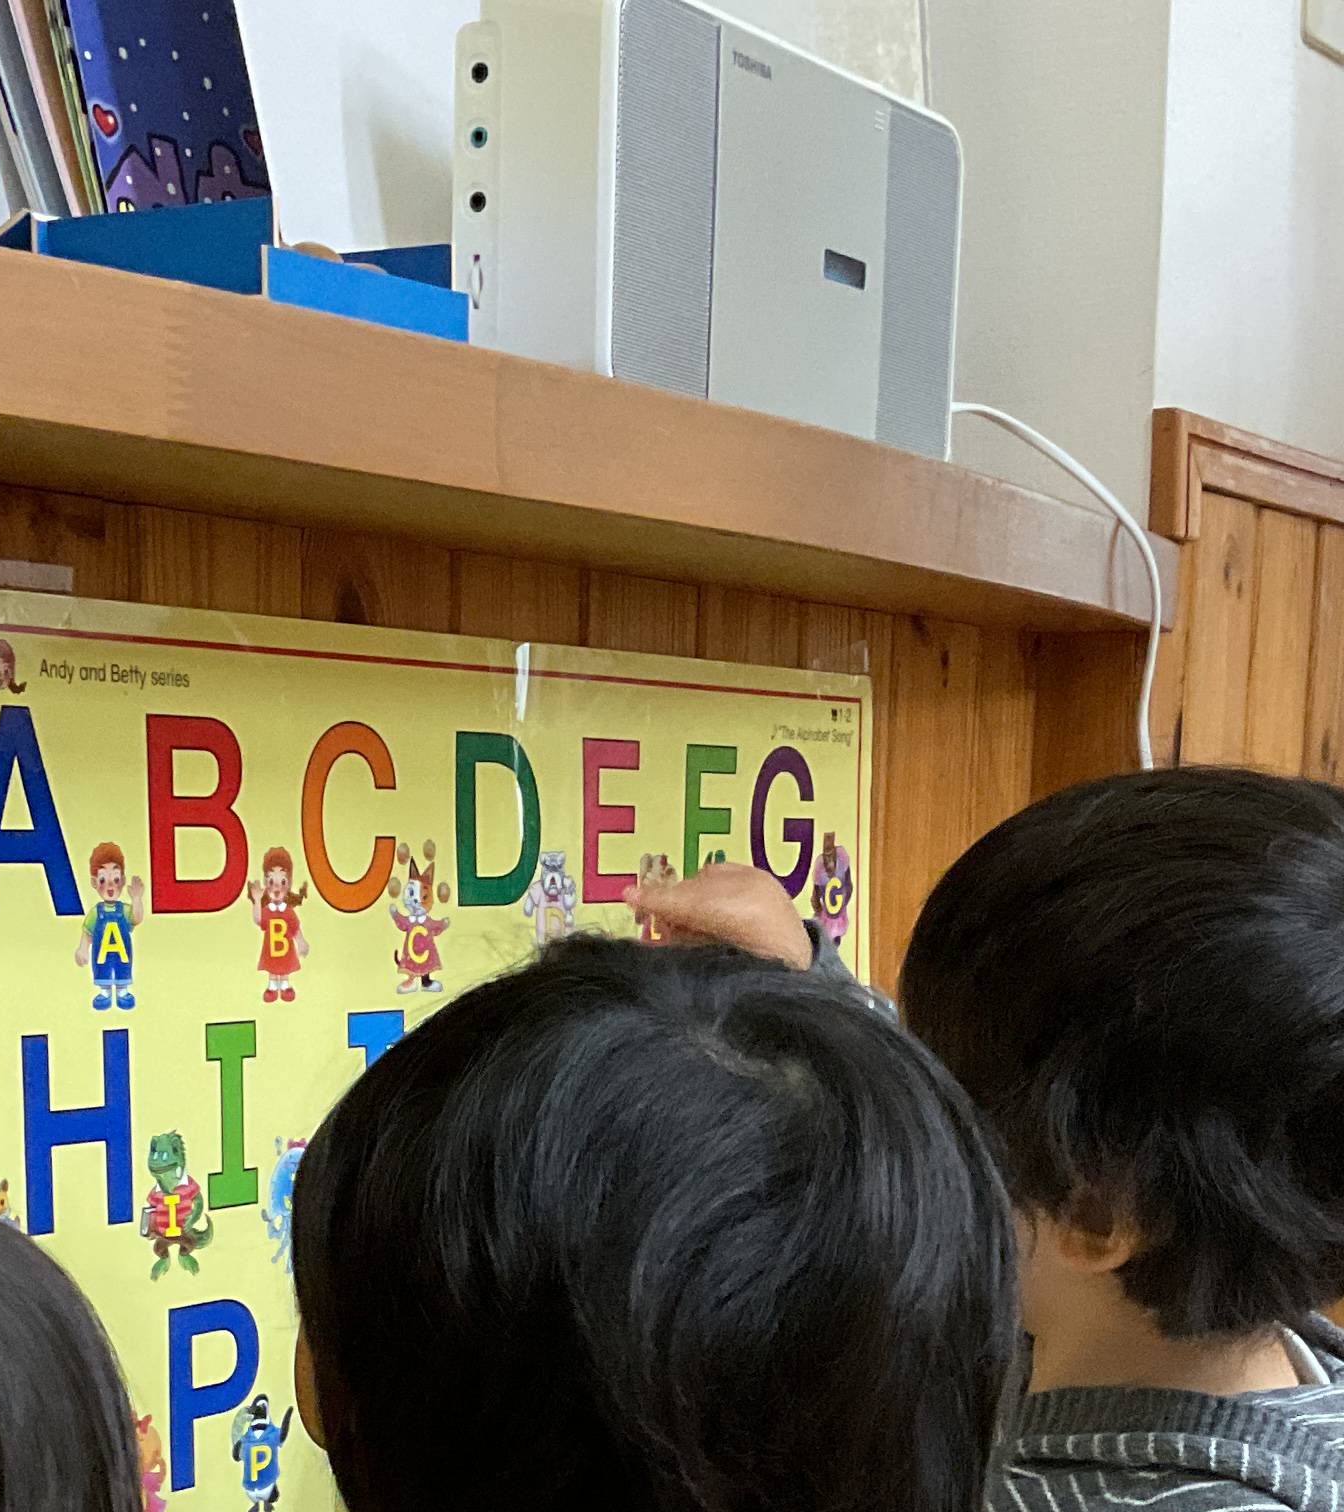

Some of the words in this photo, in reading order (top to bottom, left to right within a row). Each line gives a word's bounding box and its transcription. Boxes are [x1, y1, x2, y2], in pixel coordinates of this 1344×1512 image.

[732, 51, 773, 80] TOSHIBA
[39, 658, 75, 685] Andy
[79, 664, 106, 683] and
[110, 663, 147, 690] Betty
[150, 667, 191, 688] series
[145, 713, 249, 914] B
[301, 720, 397, 913] C
[455, 730, 542, 907] D
[582, 737, 641, 904] E
[683, 743, 738, 880] F
[750, 745, 816, 901] G
[823, 875, 840, 914] G
[96, 921, 130, 965] A
[268, 918, 290, 958] B
[407, 926, 430, 964] C
[20, 1028, 134, 1236] H
[205, 1020, 259, 1210] I
[163, 1194, 182, 1237] I
[168, 1299, 260, 1492] P
[250, 1445, 273, 1481] P
